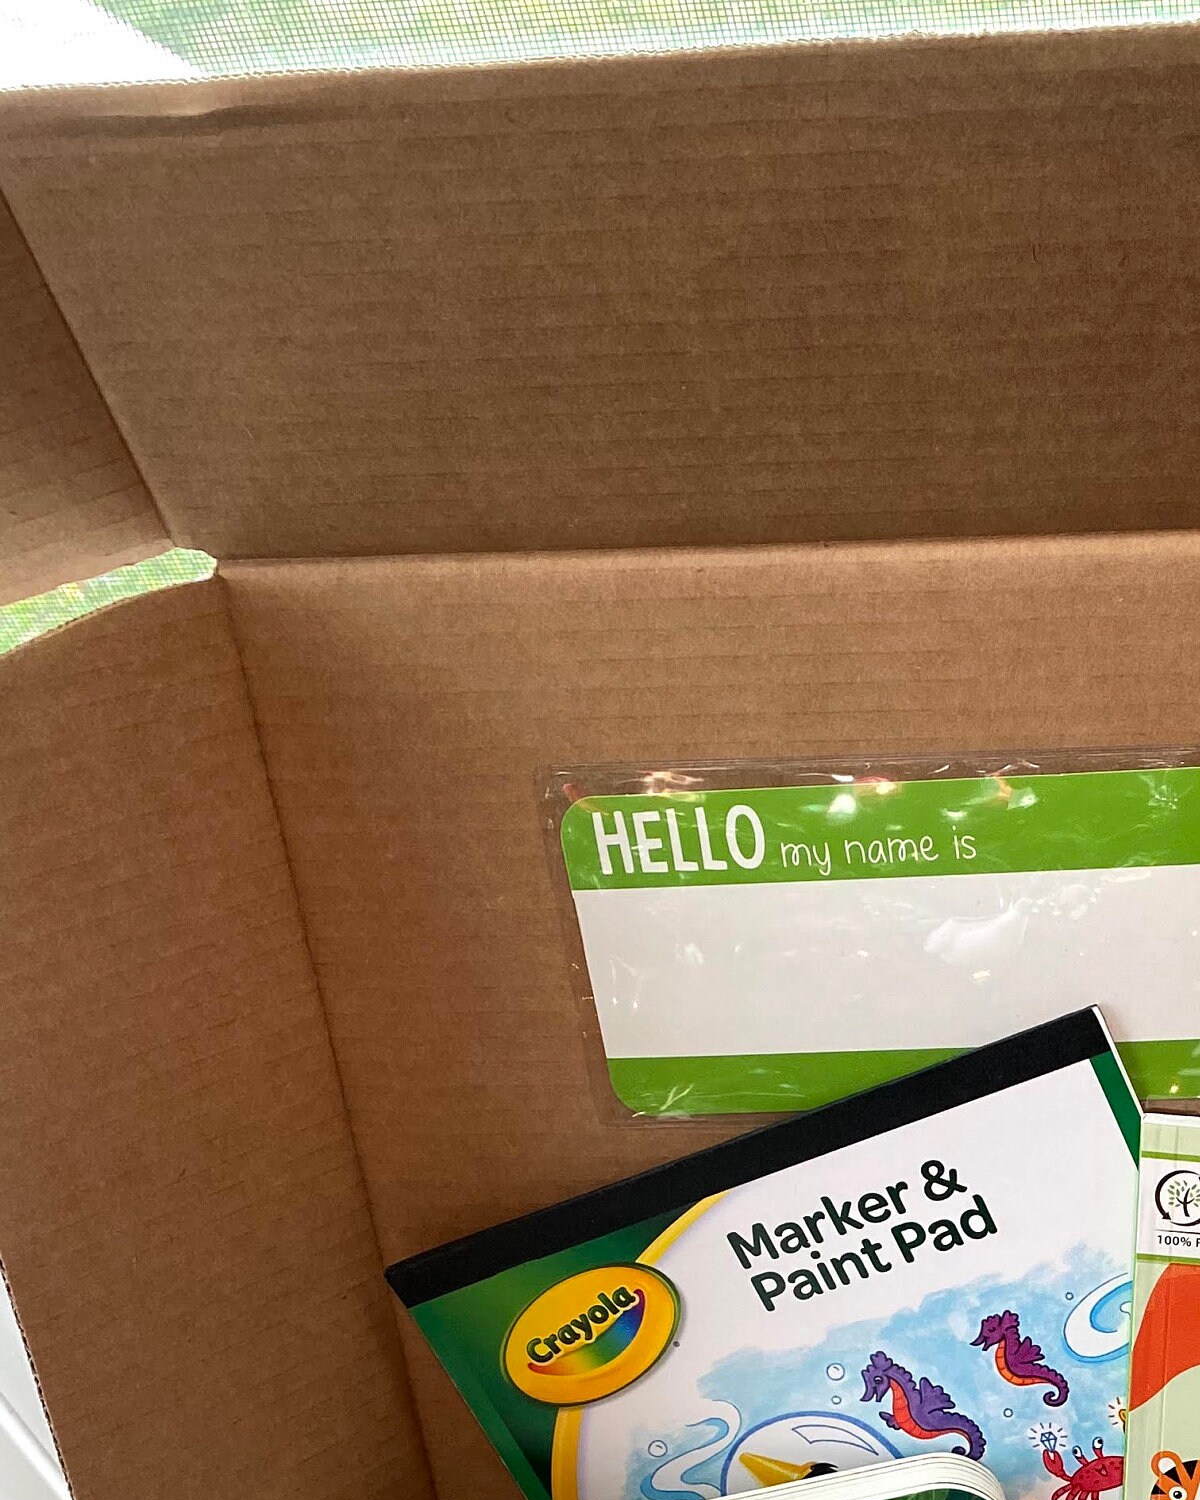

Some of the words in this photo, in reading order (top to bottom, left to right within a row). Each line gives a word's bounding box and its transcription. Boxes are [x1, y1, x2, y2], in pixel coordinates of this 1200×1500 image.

[590, 804, 767, 875] HELLO
[780, 841, 832, 876] my
[844, 838, 940, 865] name
[952, 825, 977, 861] is
[726, 1177, 910, 1270] Marker
[920, 1159, 968, 1202] &
[751, 1237, 892, 1312] Paint
[894, 1194, 998, 1263] Pad
[1157, 1235, 1192, 1248] 100%
[525, 1286, 637, 1366] Crayola
